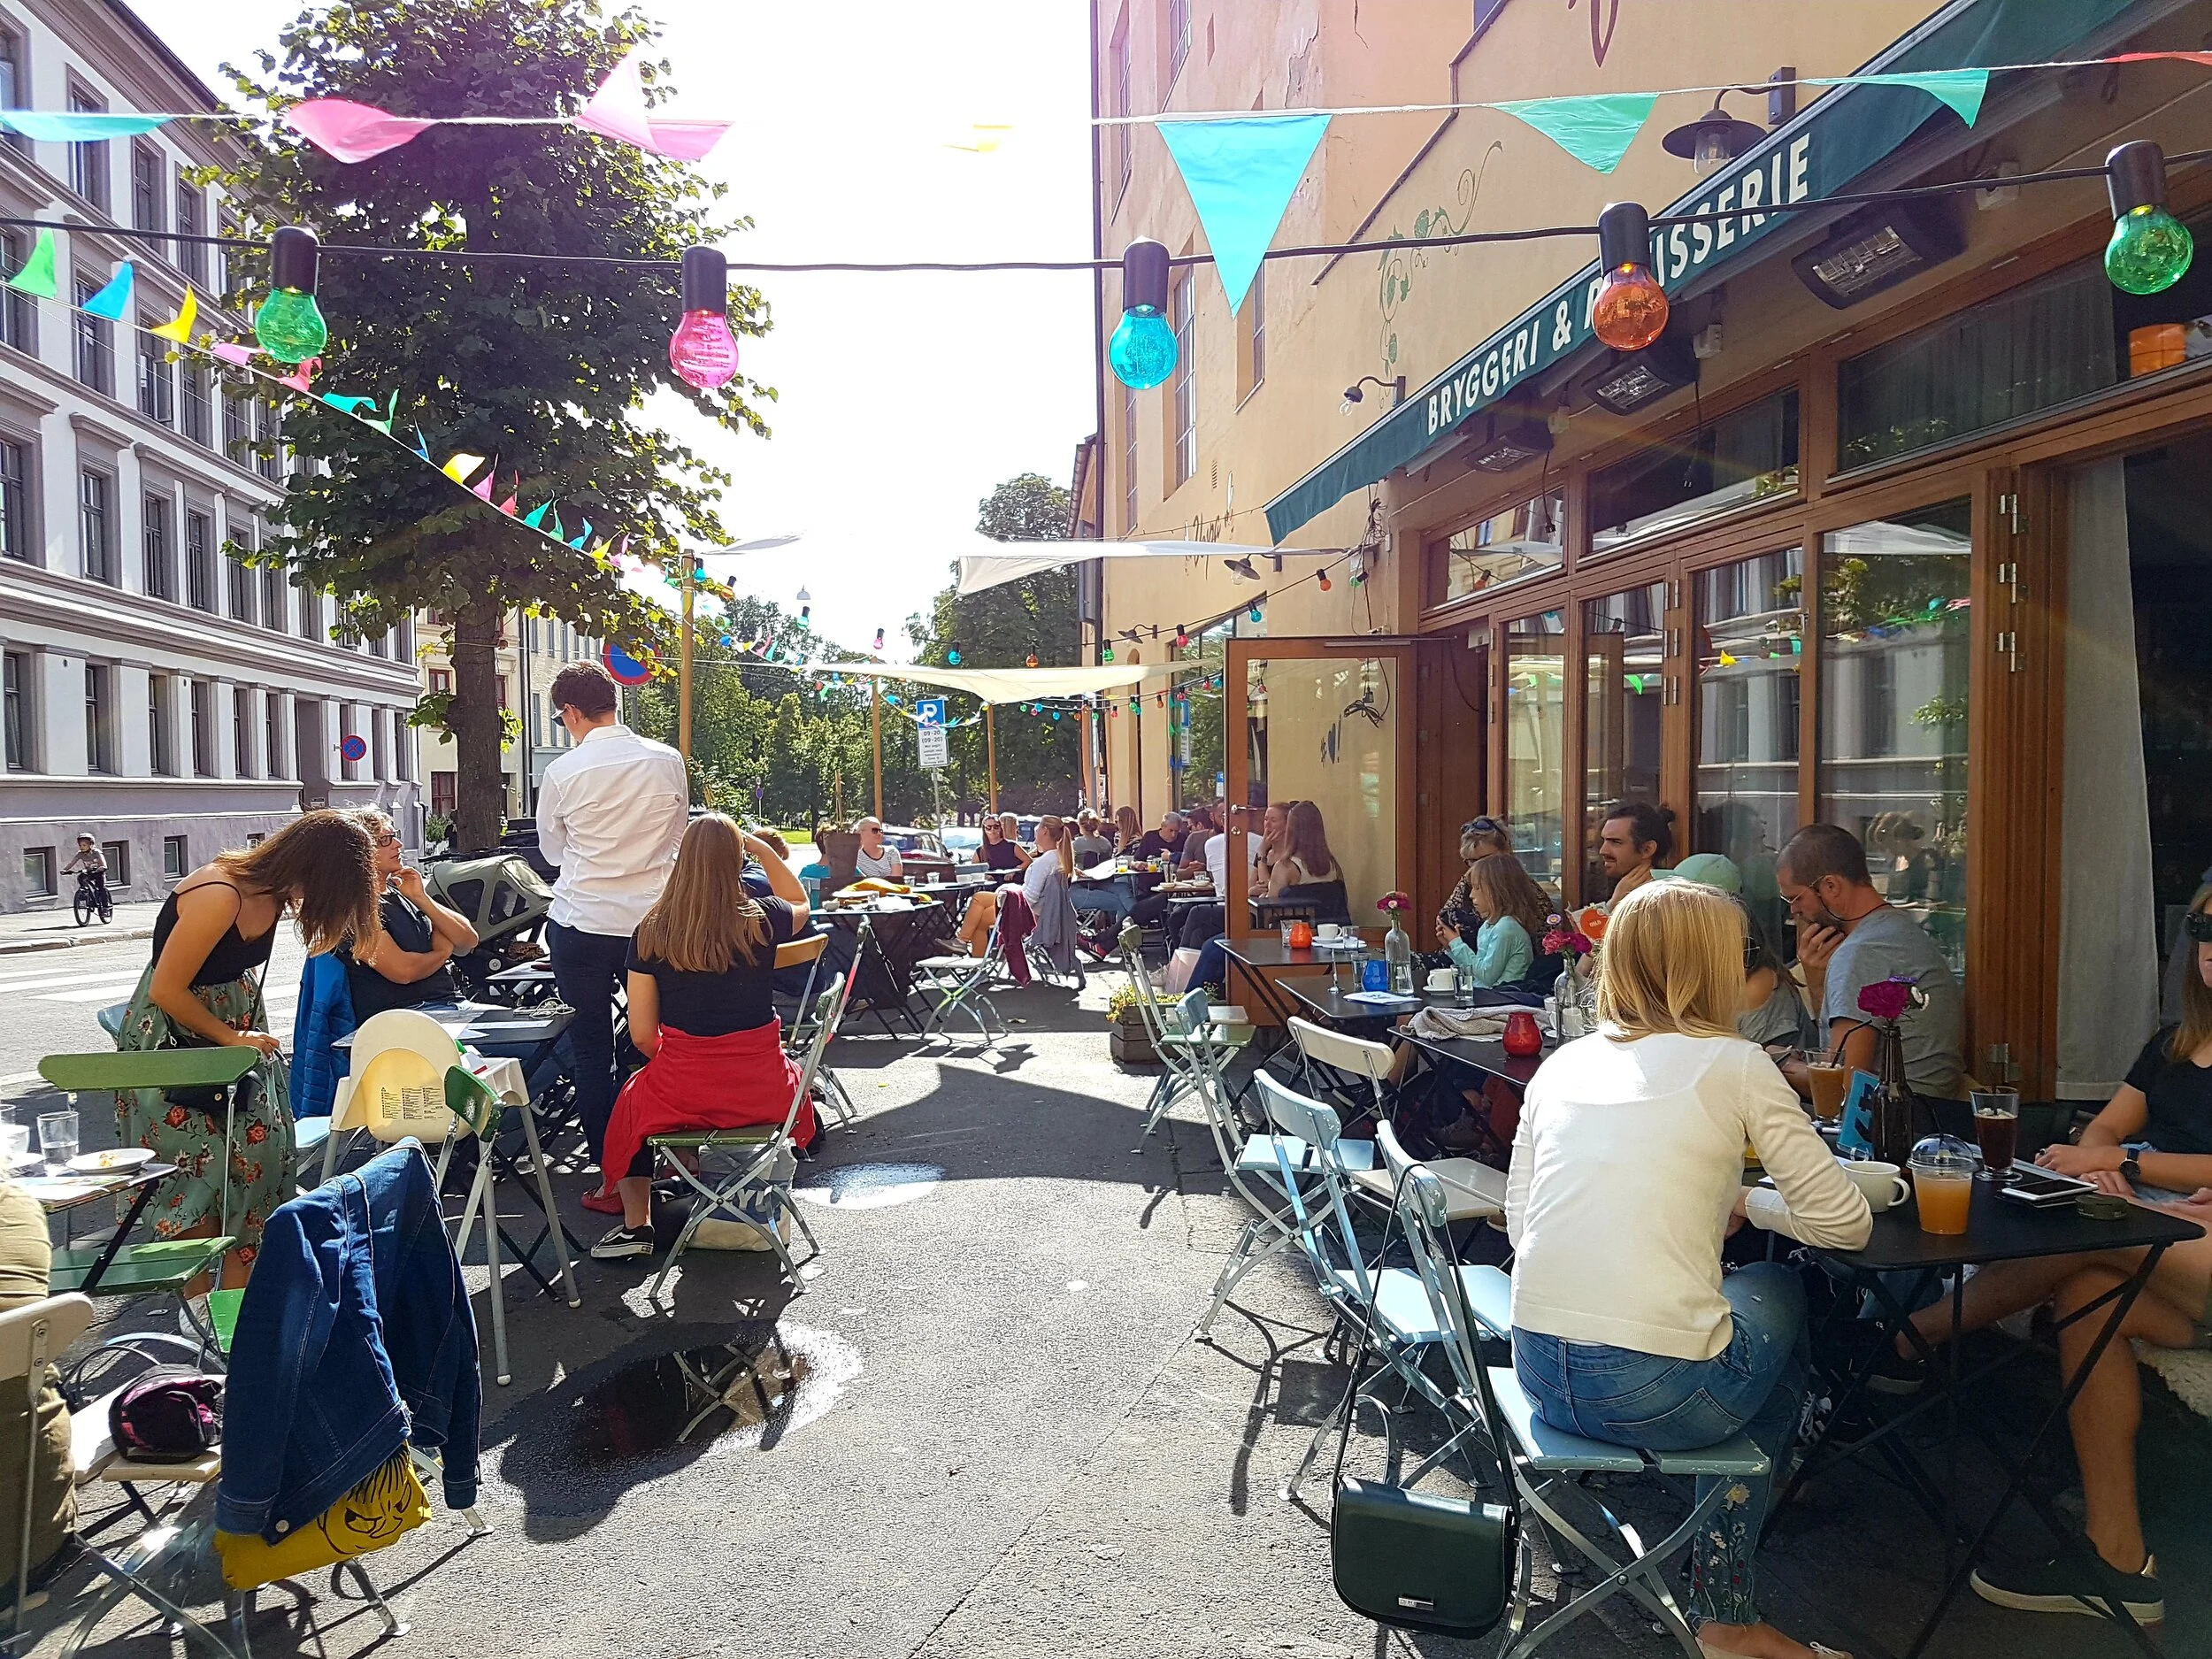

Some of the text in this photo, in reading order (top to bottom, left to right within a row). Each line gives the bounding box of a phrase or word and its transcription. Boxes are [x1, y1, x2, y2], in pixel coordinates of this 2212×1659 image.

[1428, 319, 1540, 435] BRYGGERI
[1552, 300, 1572, 351] &
[923, 703, 938, 724] P
